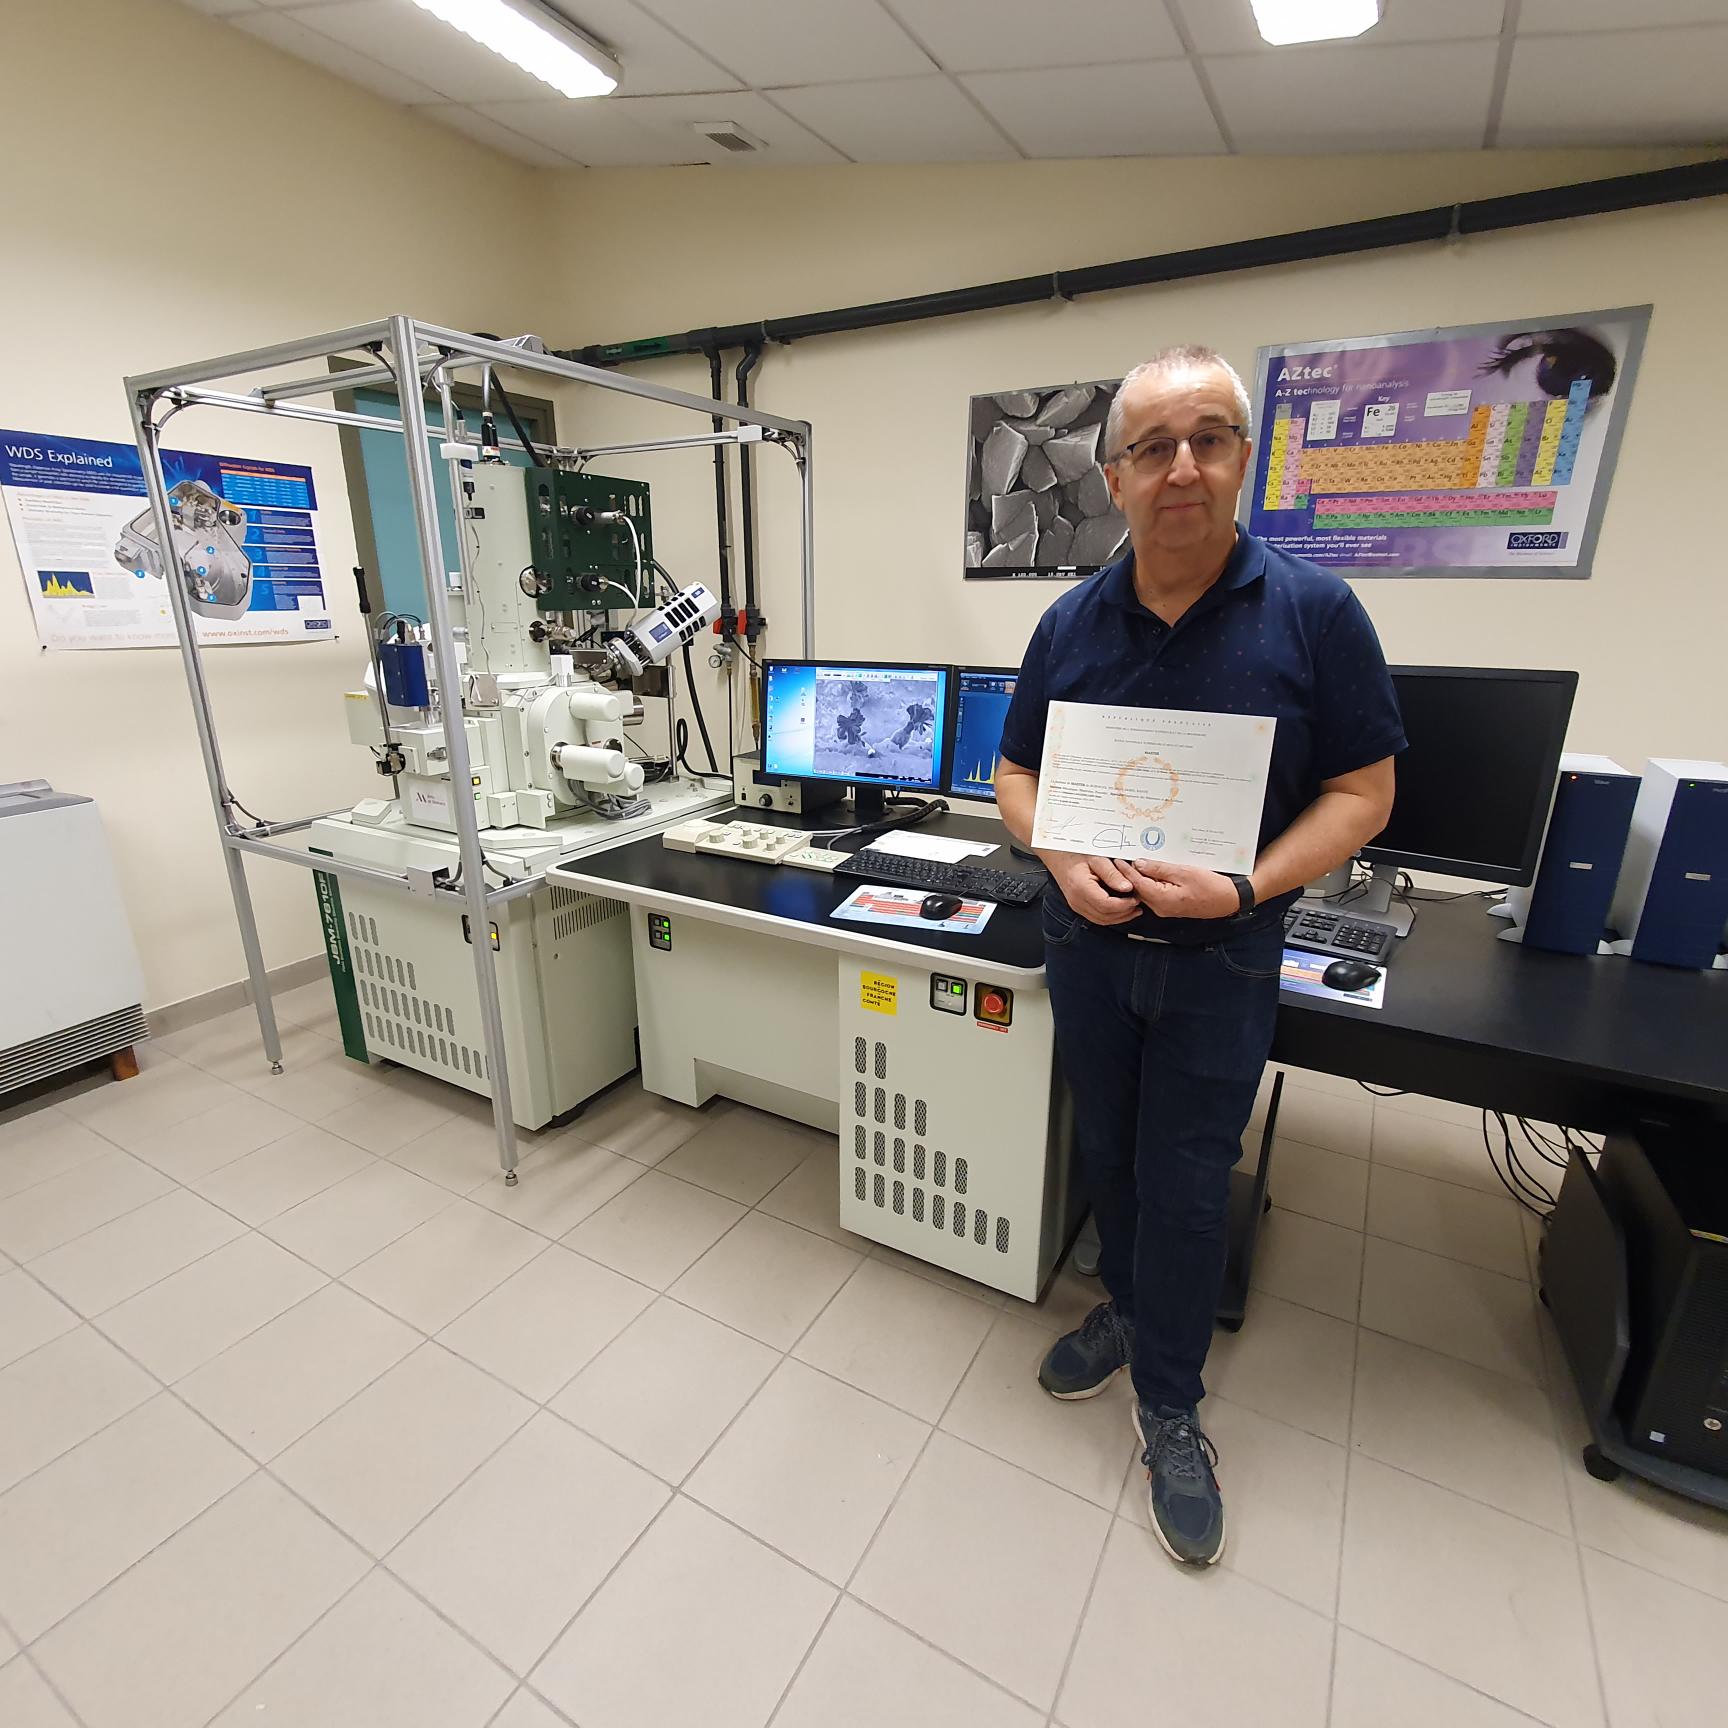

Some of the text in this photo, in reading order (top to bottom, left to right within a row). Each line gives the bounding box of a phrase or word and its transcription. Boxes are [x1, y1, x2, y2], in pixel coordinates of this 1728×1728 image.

[1277, 366, 1333, 381] AZtec
[1275, 380, 1410, 397] A-Z technology for nanoanalysis
[1366, 407, 1380, 417] Fe
[5, 444, 113, 468] WDS Explained
[1511, 534, 1558, 544] OXFORD
[867, 992, 892, 1002] FRANCHE
